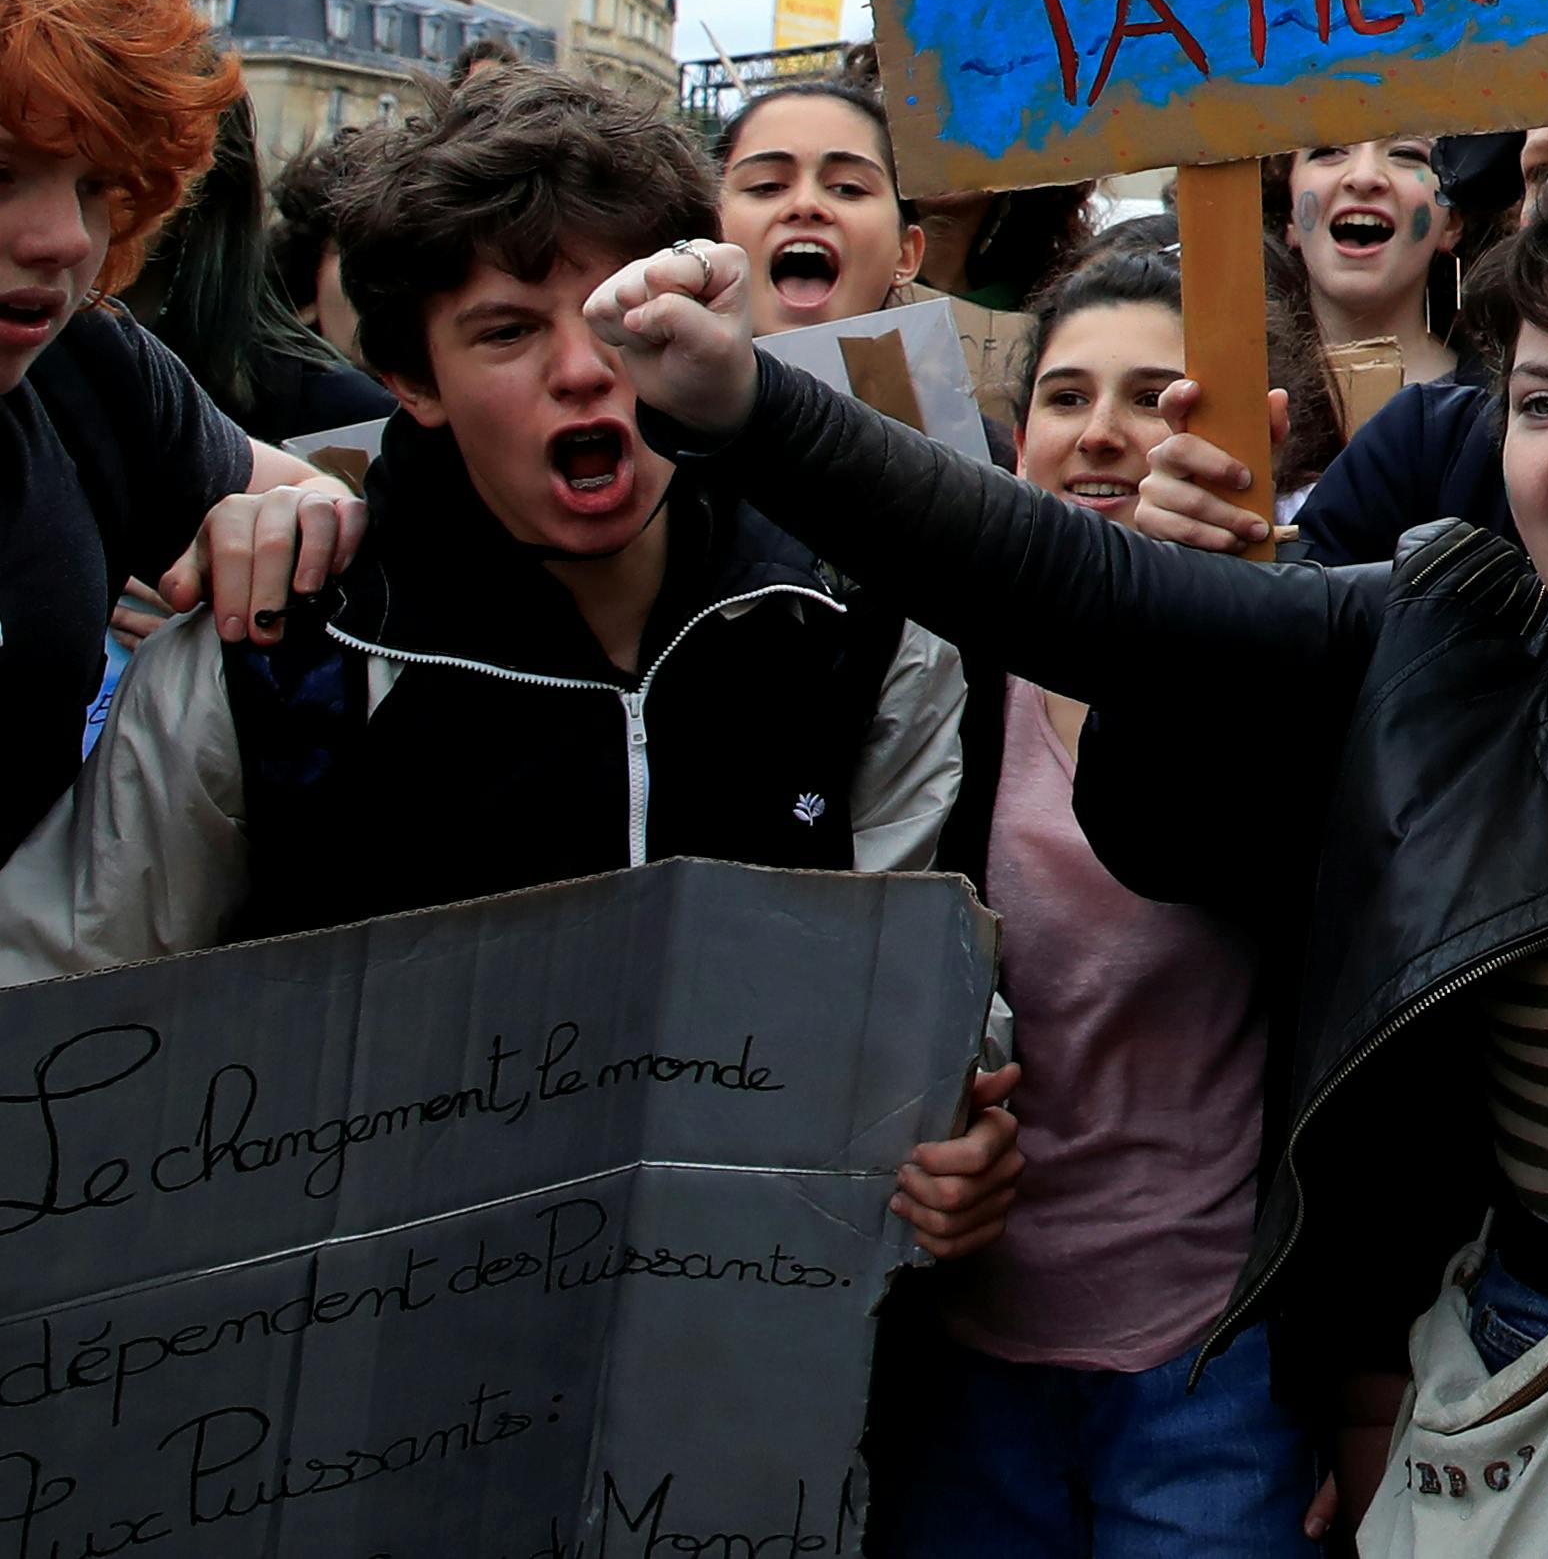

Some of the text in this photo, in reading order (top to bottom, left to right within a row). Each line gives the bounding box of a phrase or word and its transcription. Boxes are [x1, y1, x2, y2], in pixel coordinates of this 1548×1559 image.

[150, 1033, 529, 1200] changement,
[534, 1021, 592, 1100] le
[596, 1035, 786, 1093] monde
[0, 1196, 853, 1428] dépendent des Puissants.
